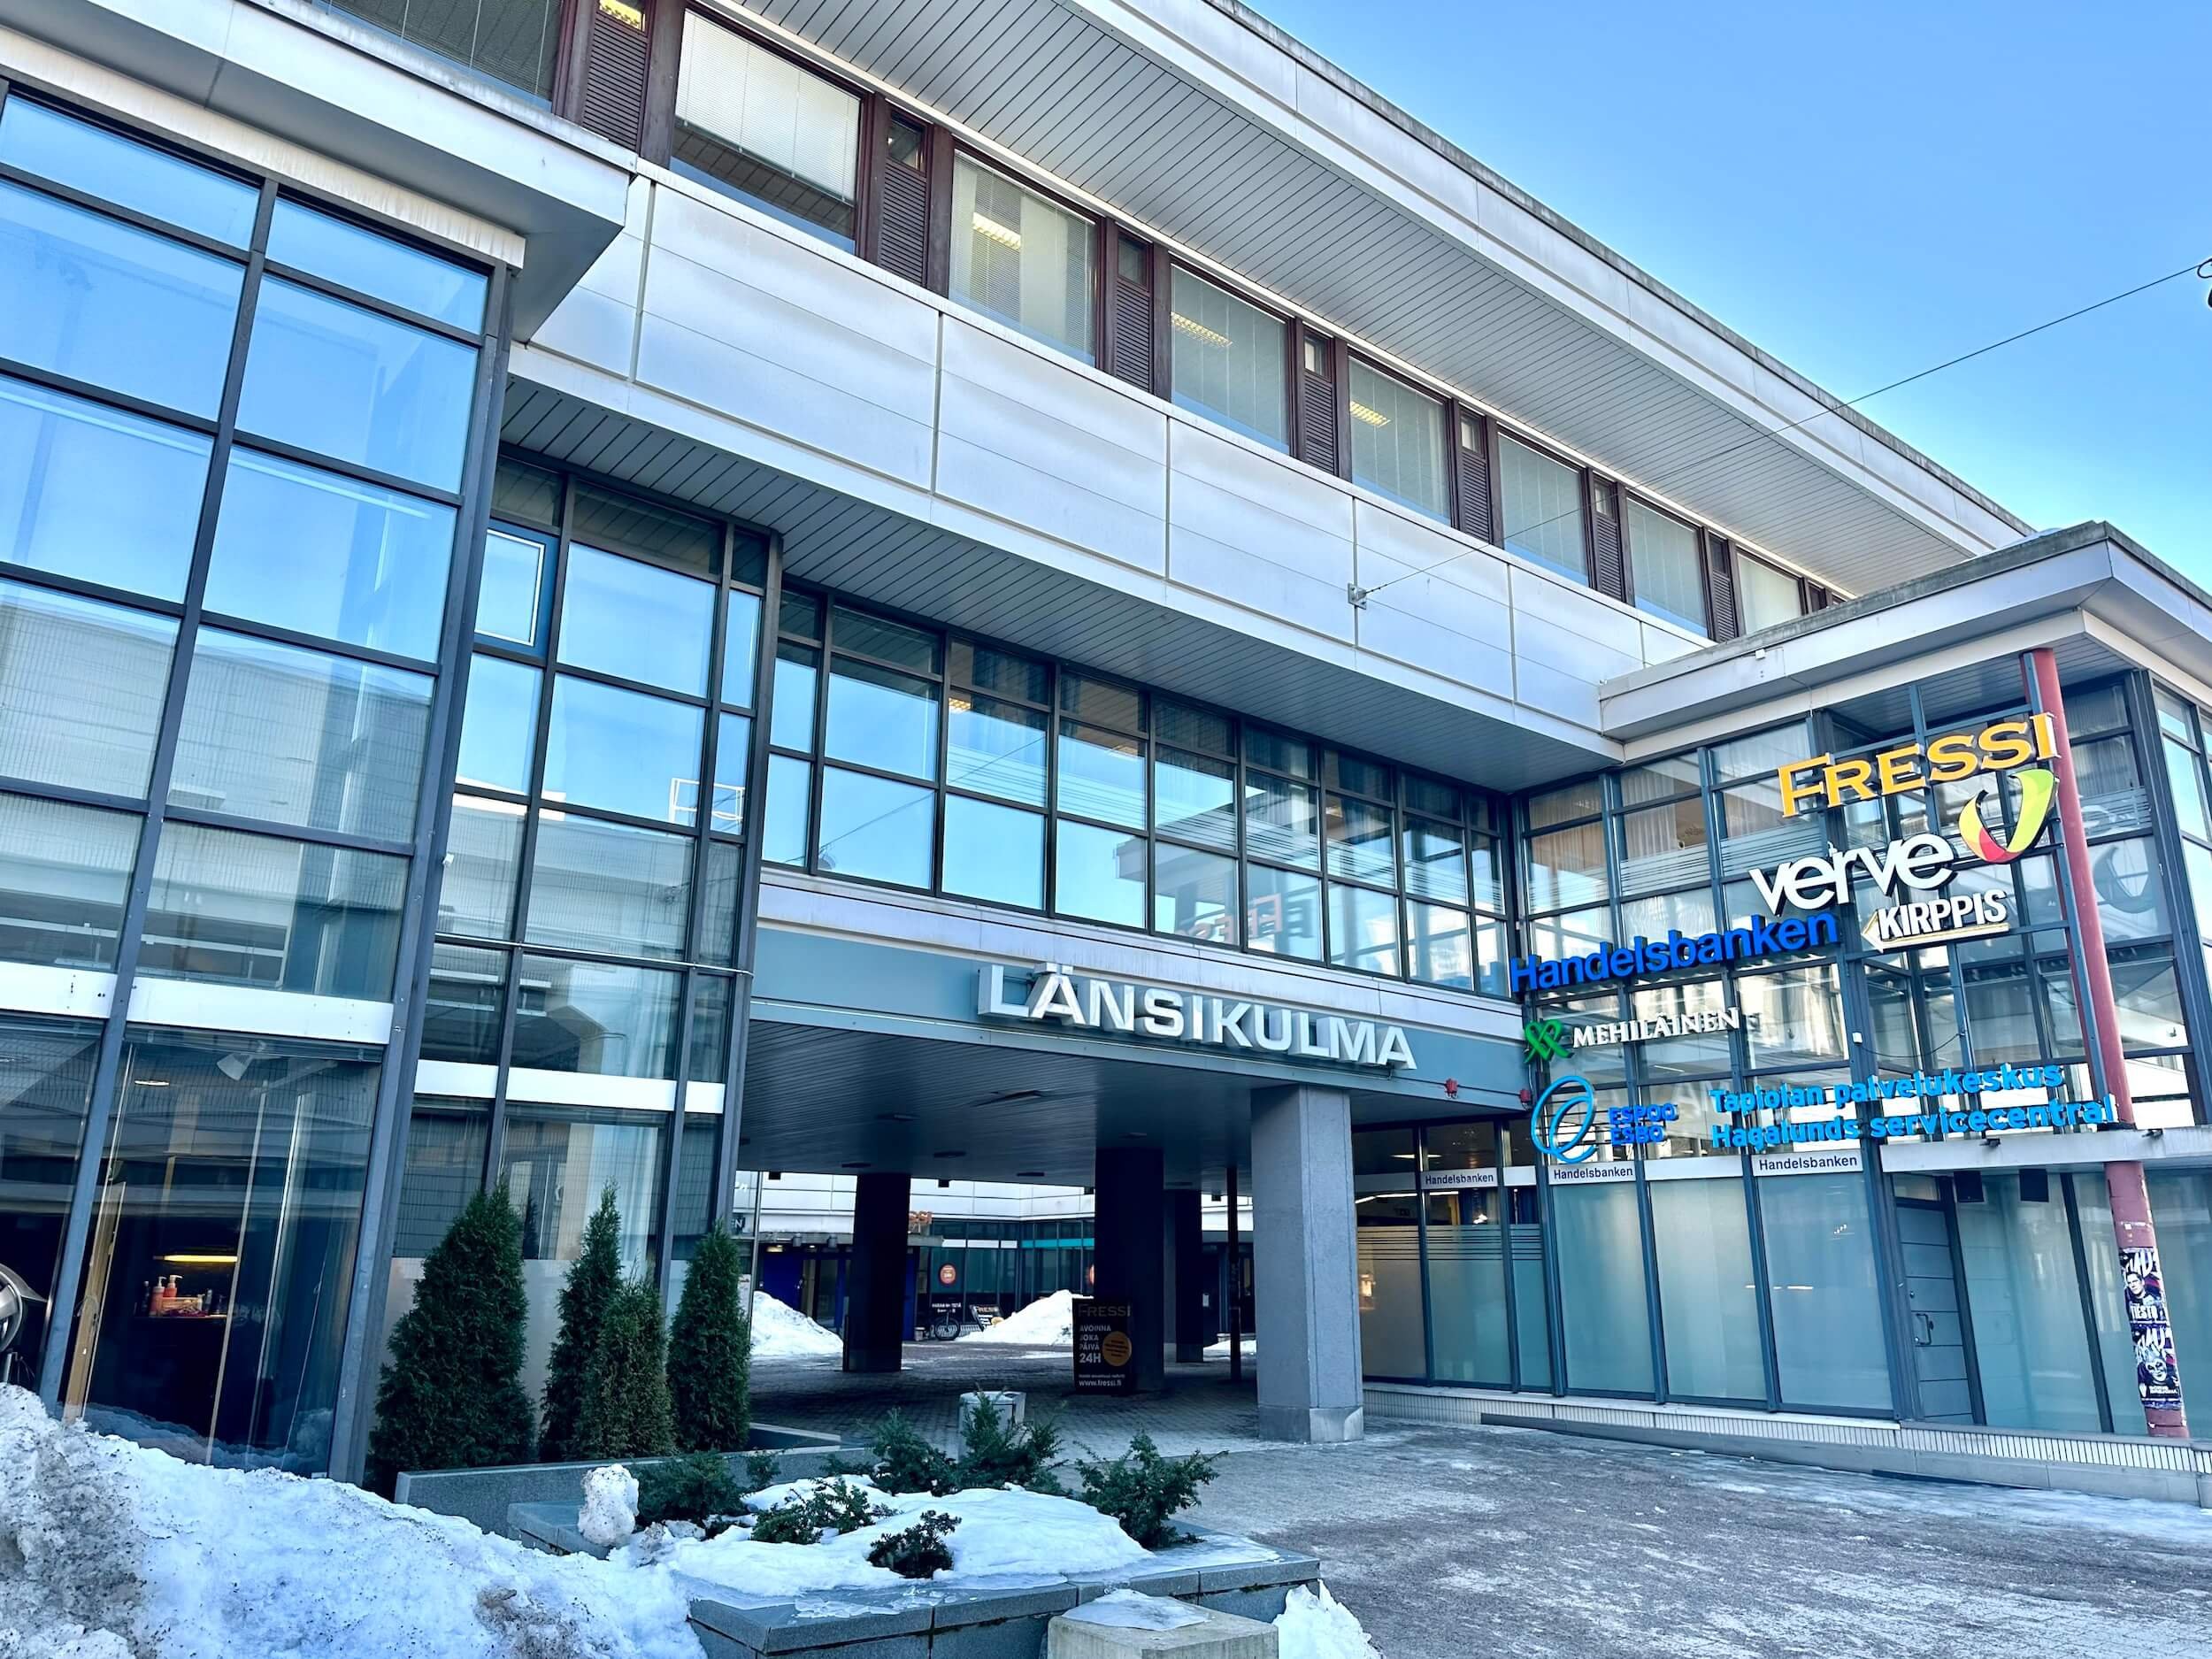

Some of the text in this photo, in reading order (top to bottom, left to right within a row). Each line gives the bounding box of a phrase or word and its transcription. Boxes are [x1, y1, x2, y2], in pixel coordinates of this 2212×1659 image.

[1777, 712, 2059, 818] FRESSI
[1749, 833, 1954, 916] verve
[1877, 889, 2008, 941] KIRPPIS
[1509, 911, 1839, 993] Handelsbanken
[978, 962, 1417, 1070] LÄNSIKULMA
[1573, 1007, 1740, 1048] MEHILÄINEN
[1709, 1063, 2064, 1114] Tapiolan palvelukeskus
[1609, 1103, 1678, 1125] ESPOO
[1710, 1094, 2120, 1150] Hagalunds servicecentral
[1609, 1125, 1666, 1146] ESBO
[1425, 1171, 1494, 1186] Handelsbanken
[1553, 1165, 1634, 1179] Handelsbanken
[1758, 1154, 1858, 1171] Handelsbanken
[1078, 1303, 1132, 1317] FRESSI
[1079, 1352, 1102, 1363] 24H
